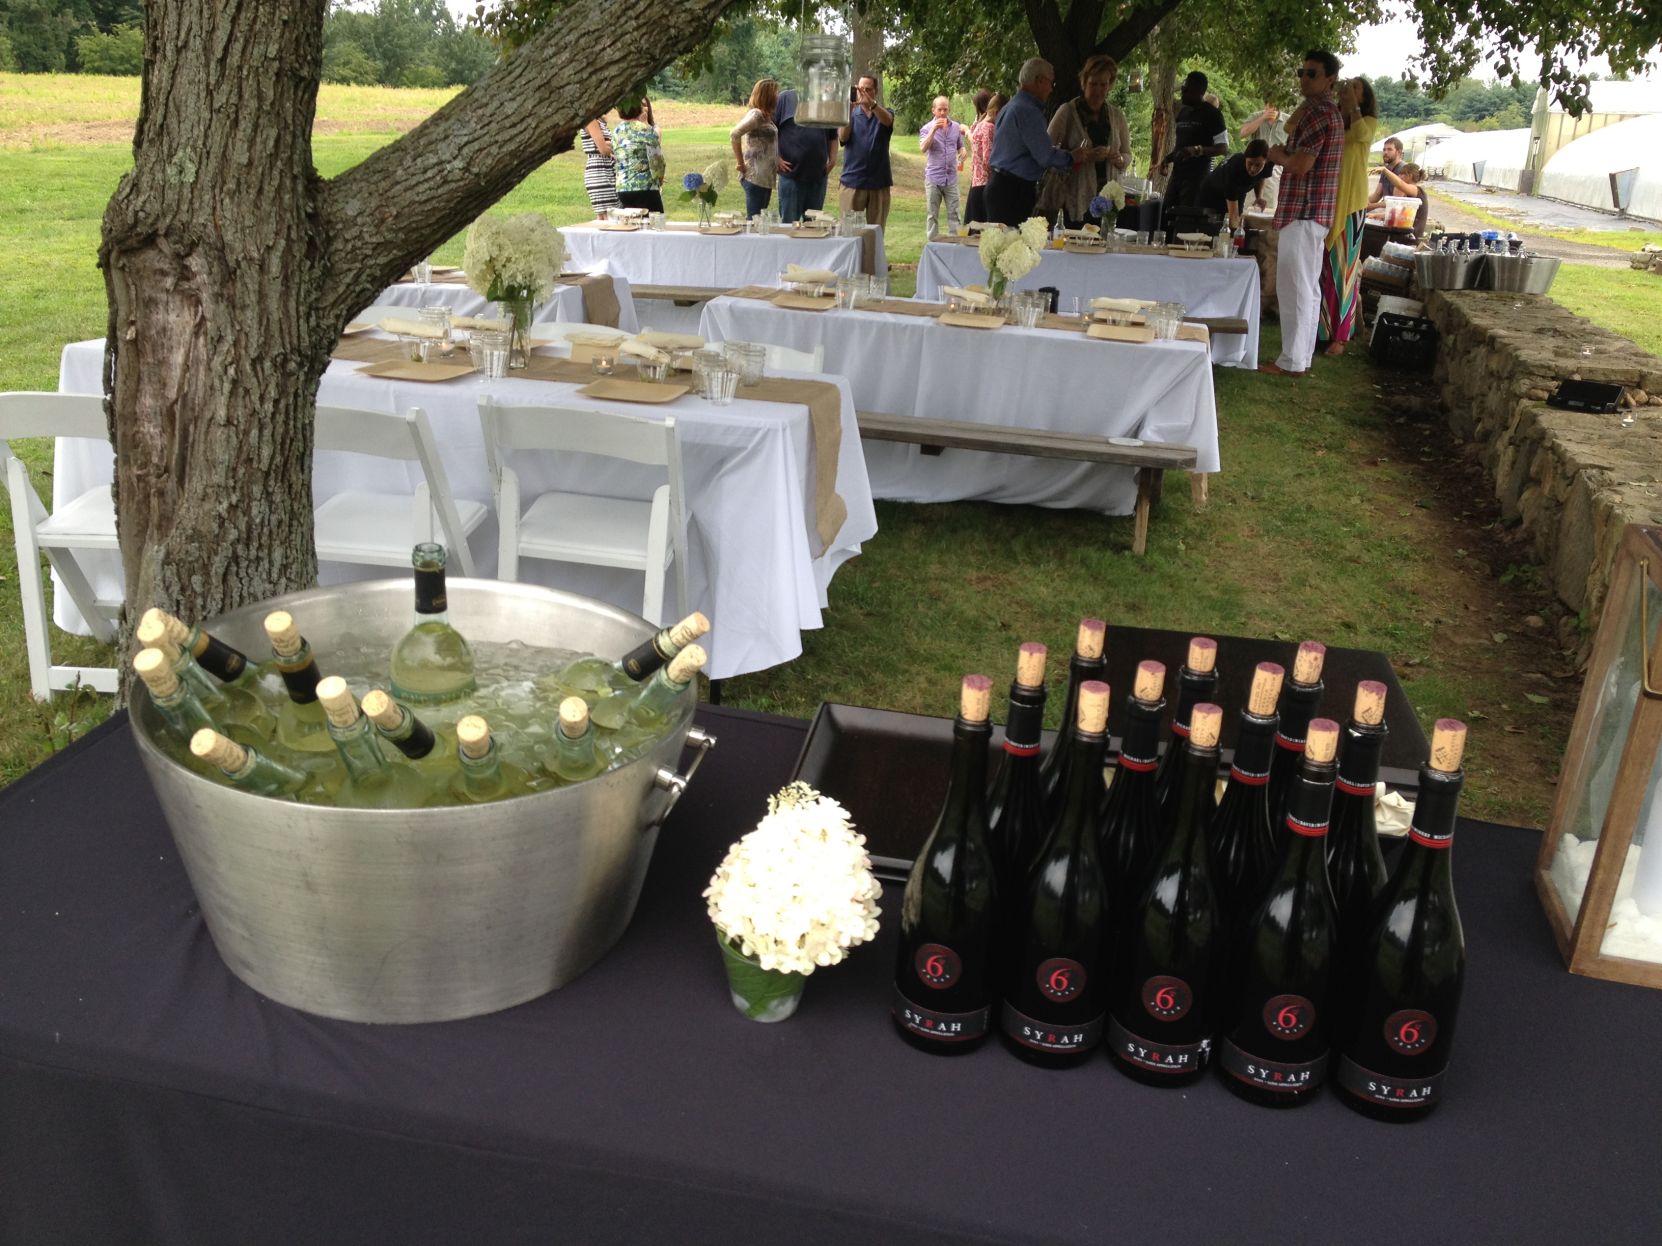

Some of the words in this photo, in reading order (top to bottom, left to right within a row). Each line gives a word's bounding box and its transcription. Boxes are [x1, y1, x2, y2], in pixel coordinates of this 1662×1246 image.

[926, 954, 946, 977] 6
[1050, 968, 1072, 991] 6
[1156, 986, 1177, 1009] 6
[904, 1009, 962, 1031] SYRAH
[1278, 1005, 1298, 1028] 6
[1023, 1026, 1083, 1044] SYRAH
[1399, 1020, 1421, 1043] 6
[1128, 1043, 1188, 1064] SYRAH
[1247, 1064, 1310, 1082] SYRAH
[1368, 1081, 1432, 1098] SYRAH
